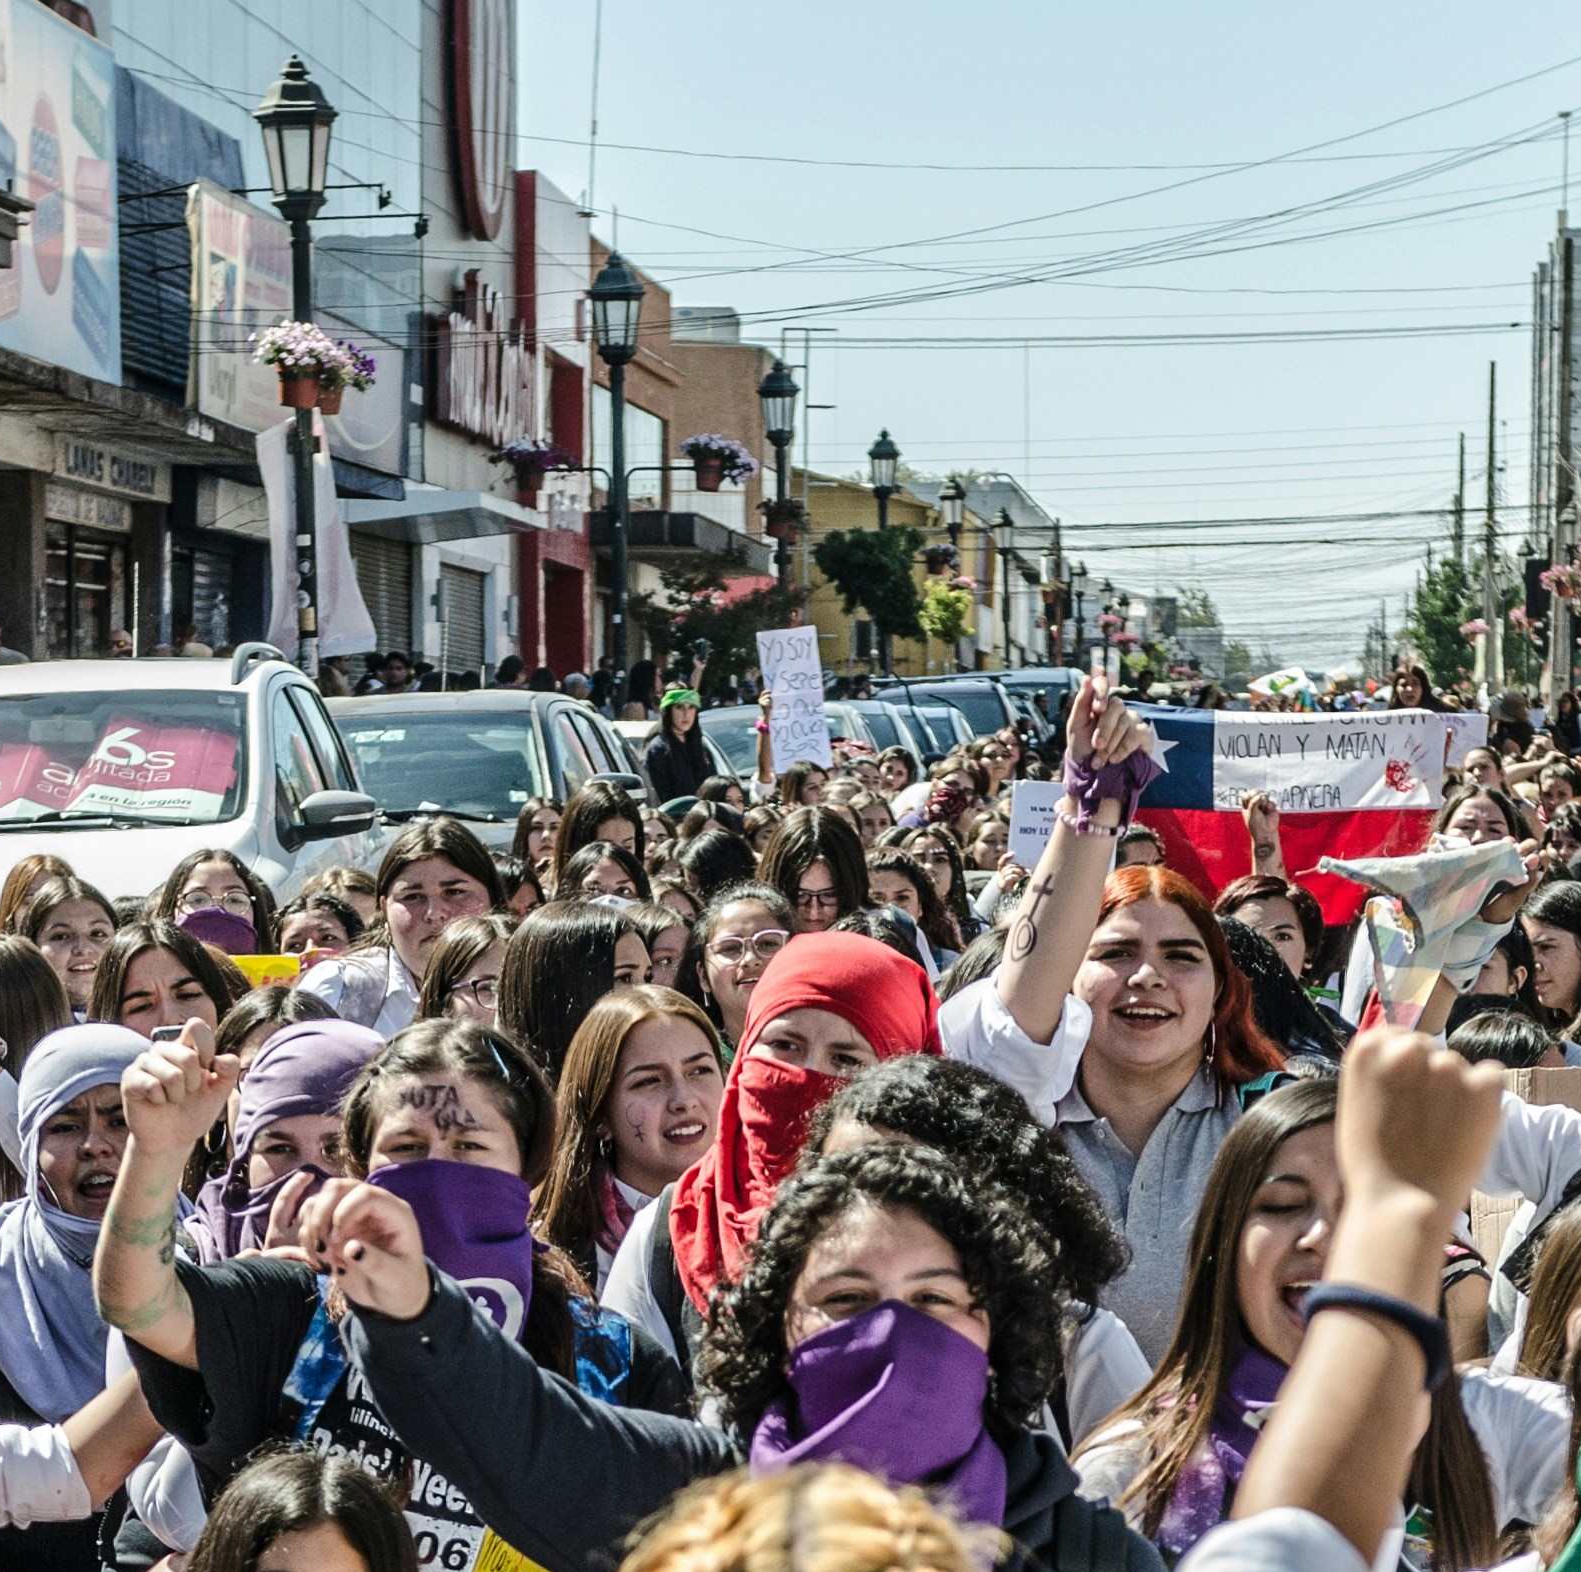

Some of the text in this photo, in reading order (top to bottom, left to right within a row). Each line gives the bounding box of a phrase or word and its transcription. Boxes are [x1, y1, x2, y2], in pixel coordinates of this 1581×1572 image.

[761, 636, 813, 666] YO SOY
[1219, 732, 1386, 760] VIOLAN Y MATAN
[1019, 826, 1037, 836] HOY
